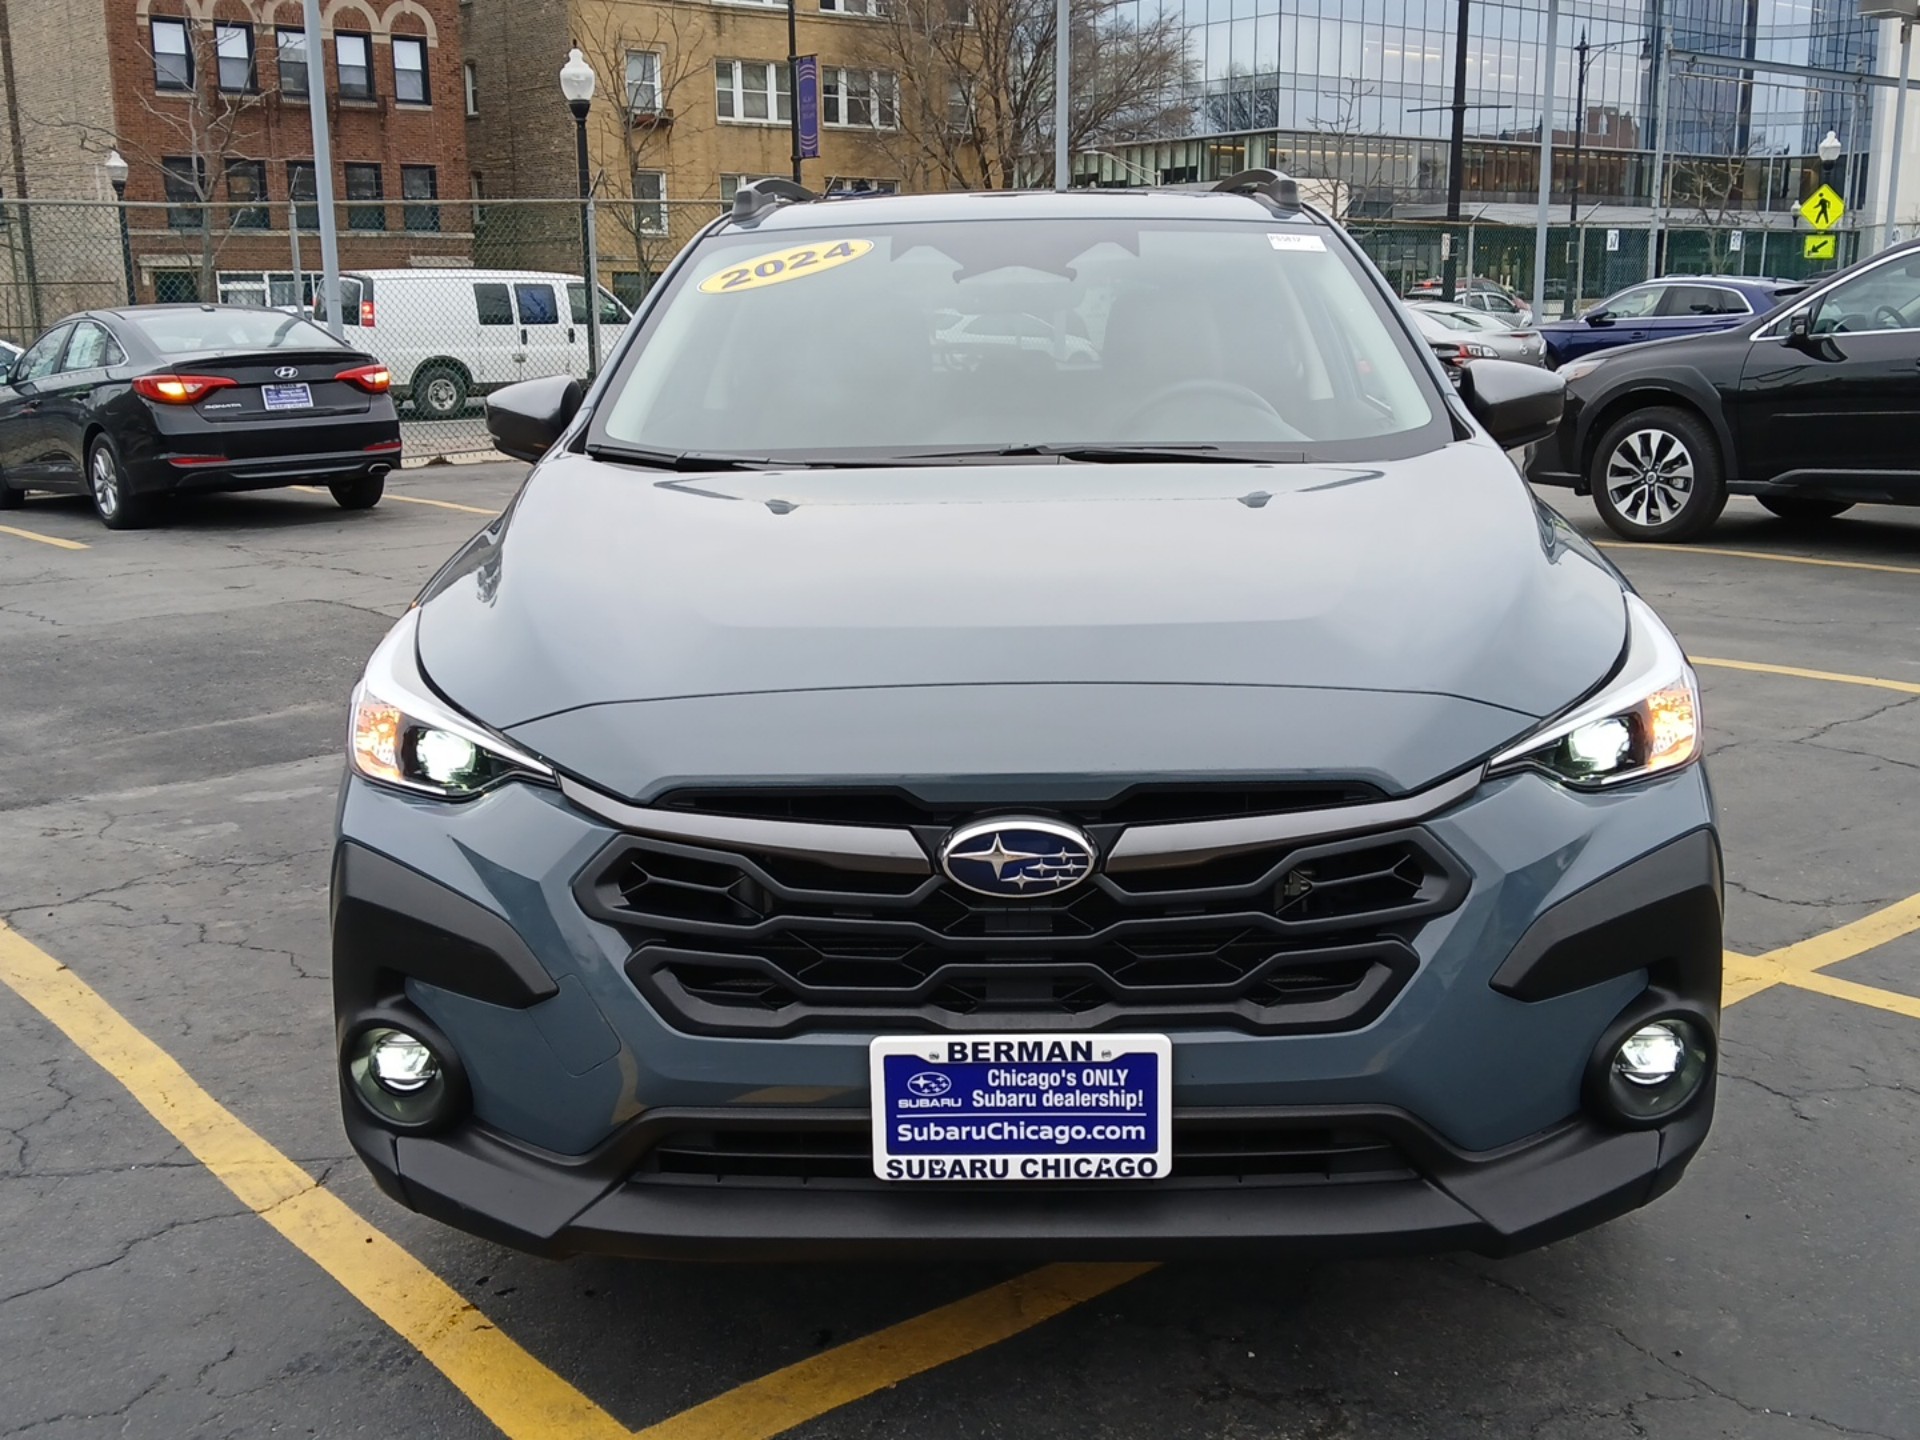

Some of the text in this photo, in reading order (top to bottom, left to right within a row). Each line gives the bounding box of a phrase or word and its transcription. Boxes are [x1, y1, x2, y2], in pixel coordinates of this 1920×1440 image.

[721, 241, 856, 290] 2024
[947, 1041, 1093, 1062] BERMAN
[987, 1068, 1129, 1090] Chicago's ONLY
[898, 1097, 962, 1109] SUBARU
[971, 1089, 1144, 1110] Subaru dealership!
[897, 1121, 1146, 1144] SubaruChicago.com
[886, 1157, 1159, 1179] SUBARU CHICAGO
